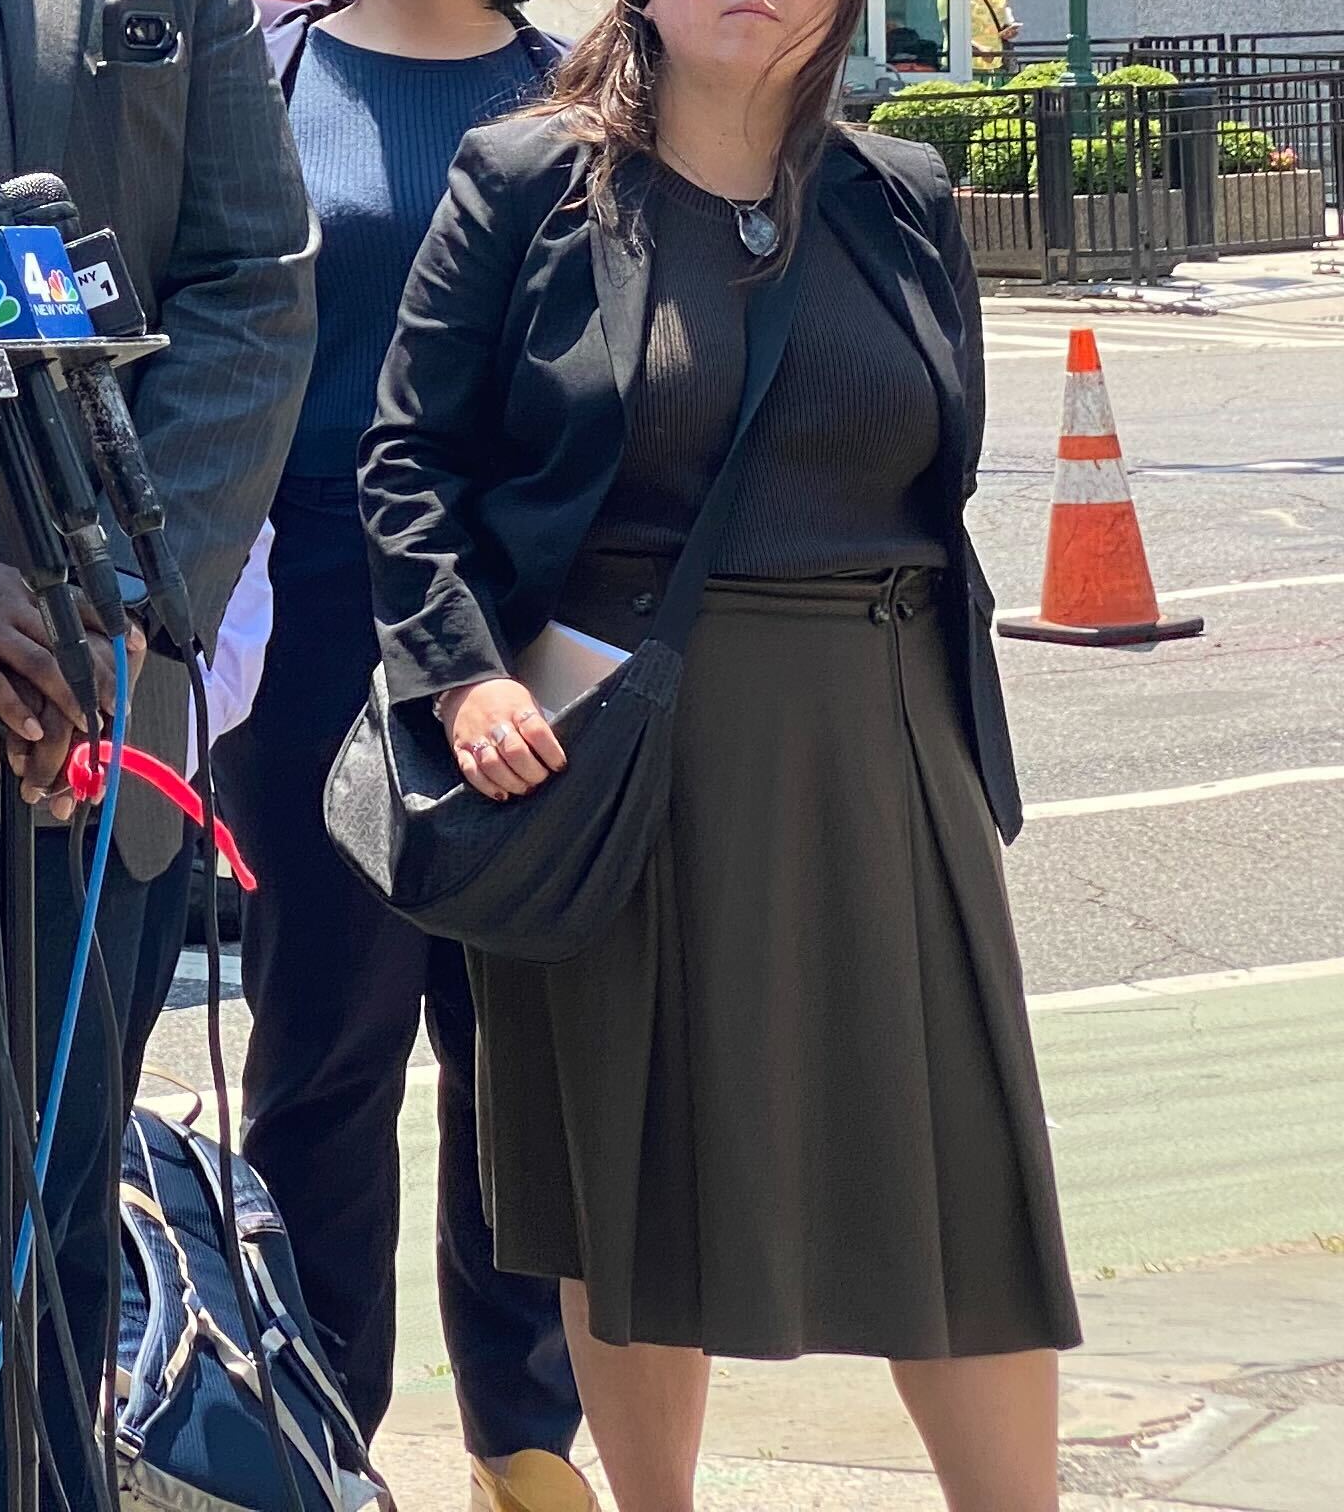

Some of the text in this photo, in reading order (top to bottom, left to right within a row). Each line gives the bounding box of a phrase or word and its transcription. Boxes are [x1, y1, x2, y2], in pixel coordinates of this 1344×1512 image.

[24, 252, 51, 303] 4
[77, 270, 98, 286] NY
[100, 279, 114, 297] 1
[32, 303, 85, 316] NEW YORK
